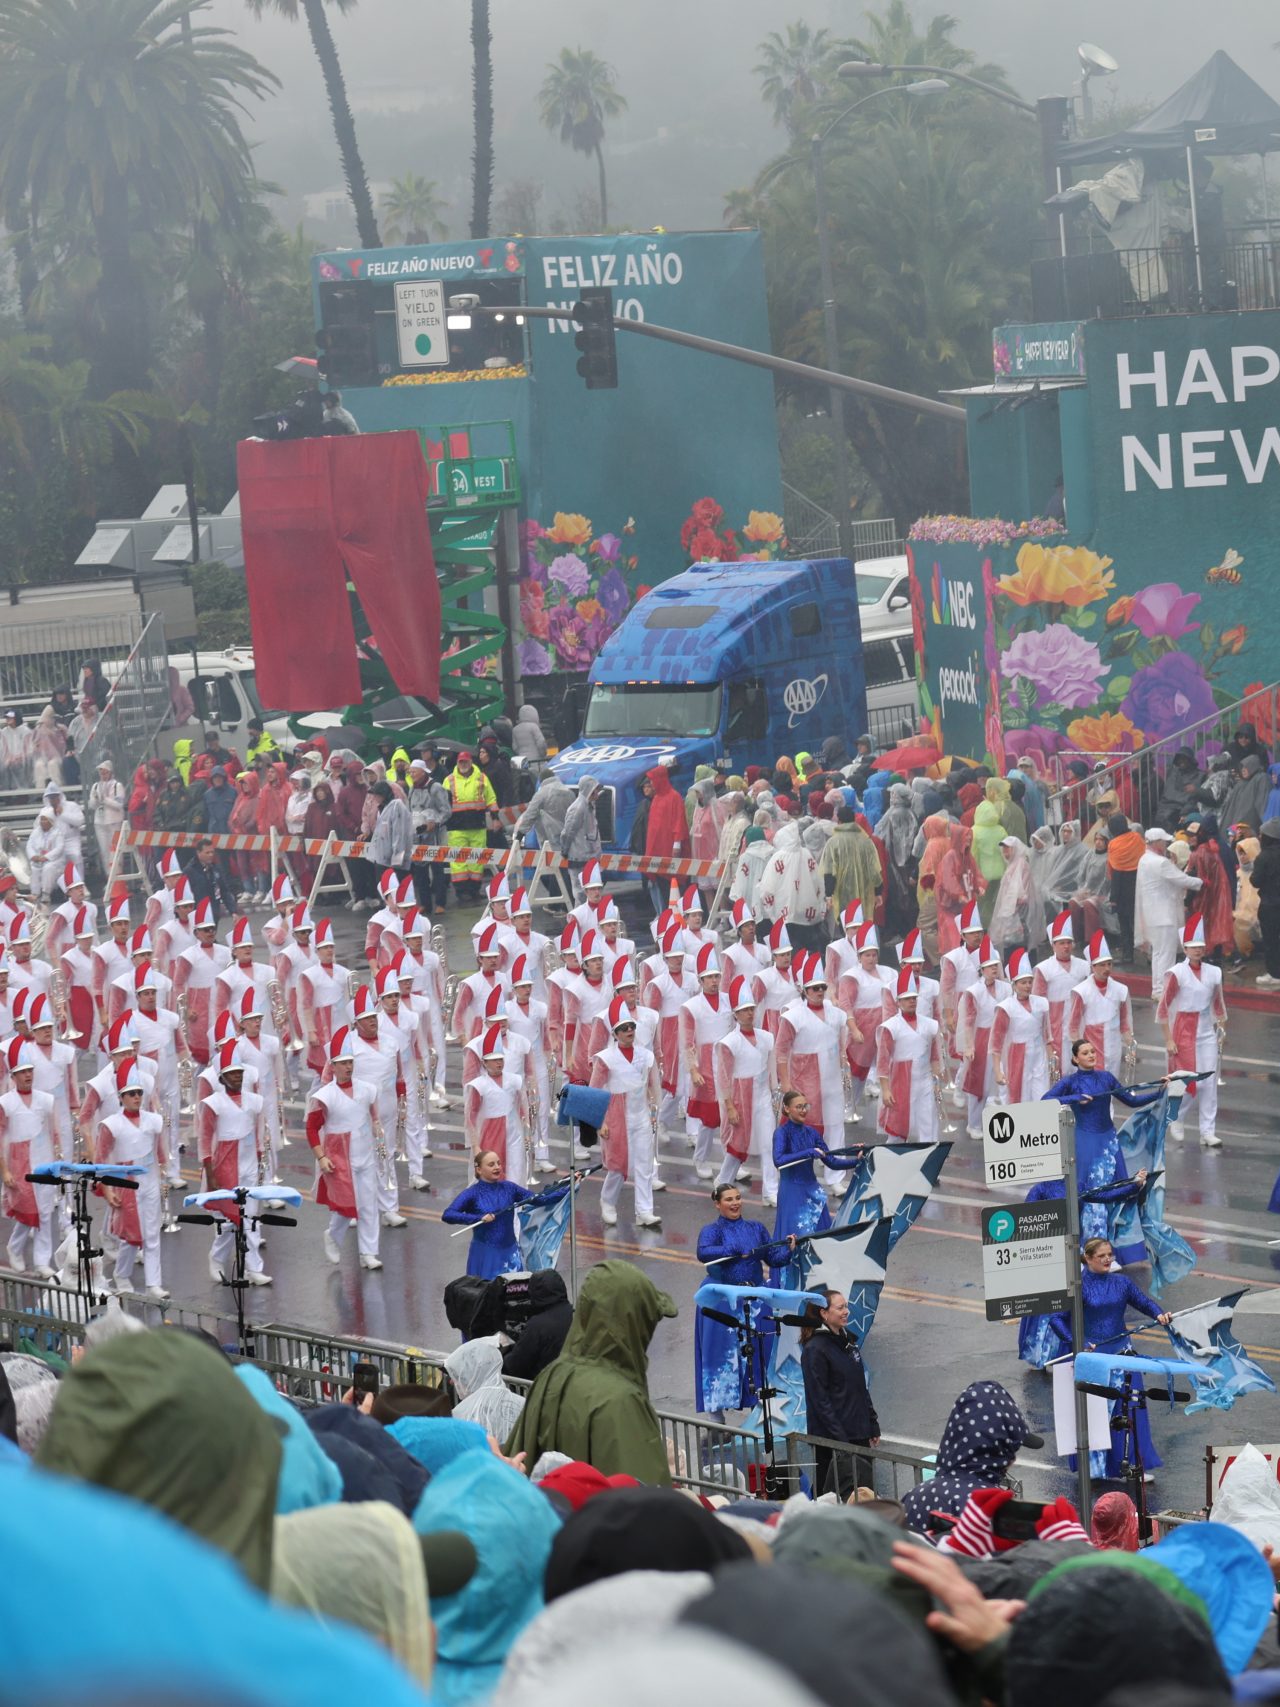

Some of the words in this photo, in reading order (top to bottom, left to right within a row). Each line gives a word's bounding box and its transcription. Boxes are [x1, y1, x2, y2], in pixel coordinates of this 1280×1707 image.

[367, 261, 399, 277] FELIZ
[400, 256, 429, 273] AÑO
[430, 255, 475, 272] NUEVO
[542, 255, 618, 289] FELIZ
[623, 243, 683, 285] AÑO
[399, 289, 416, 300] LEFT
[420, 288, 439, 298] TURN
[405, 302, 435, 314] YIELD
[402, 318, 413, 327] ON
[416, 317, 440, 327] GREEN
[452, 478, 465, 491] 34
[948, 580, 976, 630] NBC
[939, 656, 978, 719] peacock
[788, 683, 816, 712] AAA
[570, 746, 623, 763] AAA
[443, 849, 494, 861] MAINTENANCE
[1019, 1132, 1059, 1149] Metro
[989, 1162, 1016, 1180] 180
[1018, 1211, 1059, 1225] PASADENA
[1018, 1222, 1051, 1234] TRANSIT
[996, 1248, 1011, 1266] 33
[1019, 1246, 1036, 1255] Sierra
[1037, 1244, 1053, 1253] Madre
[1019, 1253, 1032, 1261] Villa
[1032, 1251, 1052, 1260] Station
